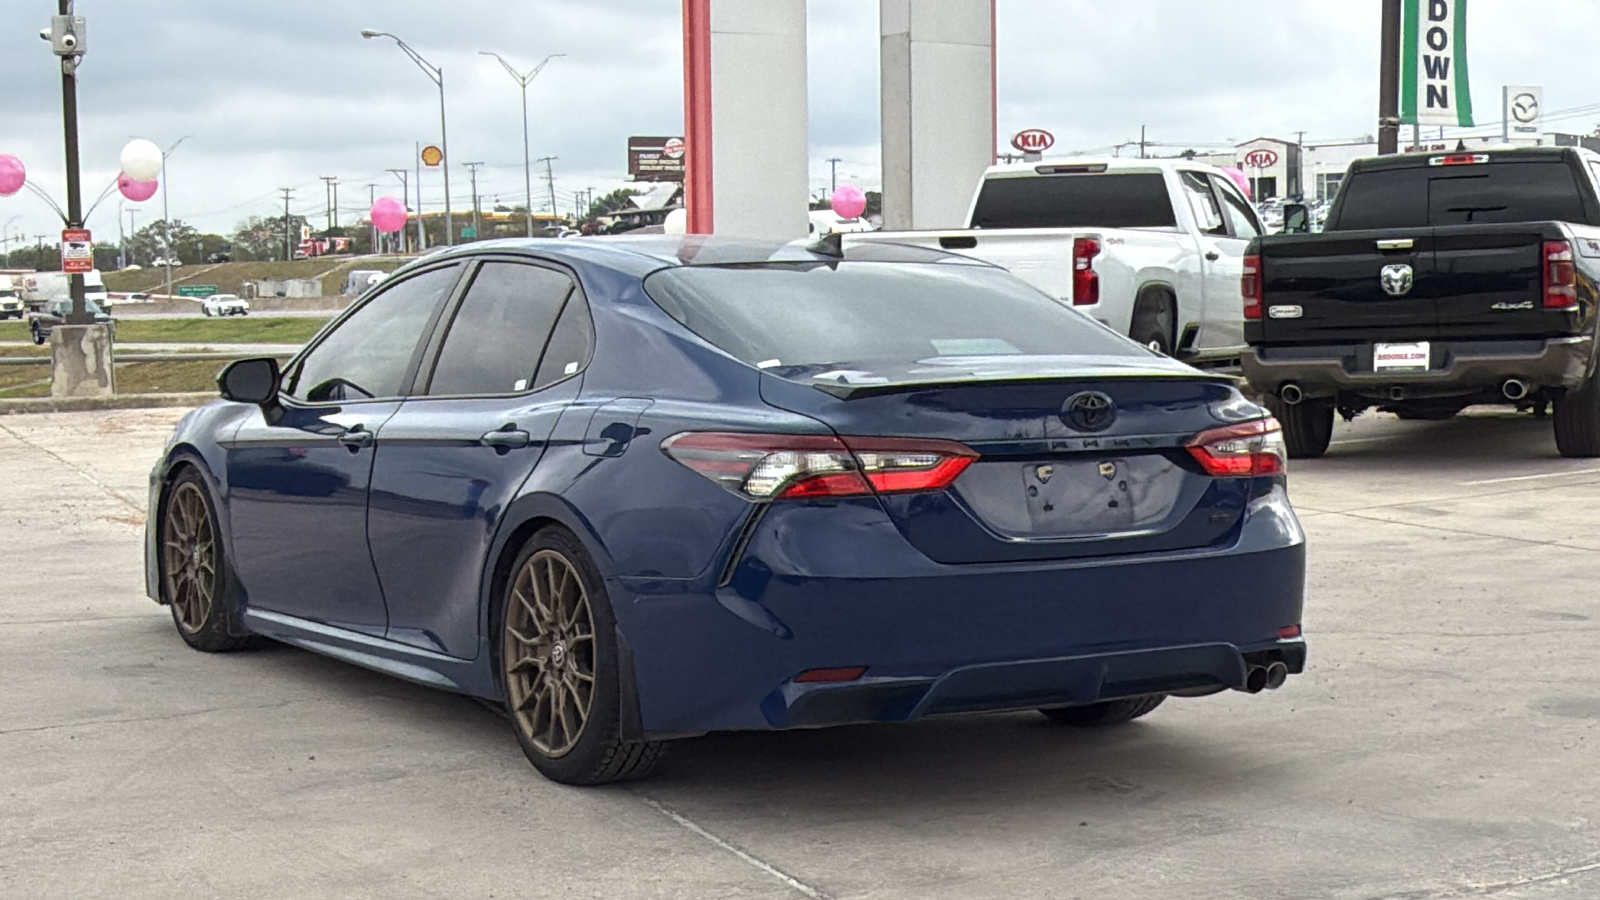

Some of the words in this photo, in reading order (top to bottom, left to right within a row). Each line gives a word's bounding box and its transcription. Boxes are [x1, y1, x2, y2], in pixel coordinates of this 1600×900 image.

[1423, 0, 1450, 108] DOWN
[1021, 134, 1048, 147] KIA
[1250, 153, 1273, 167] KIA
